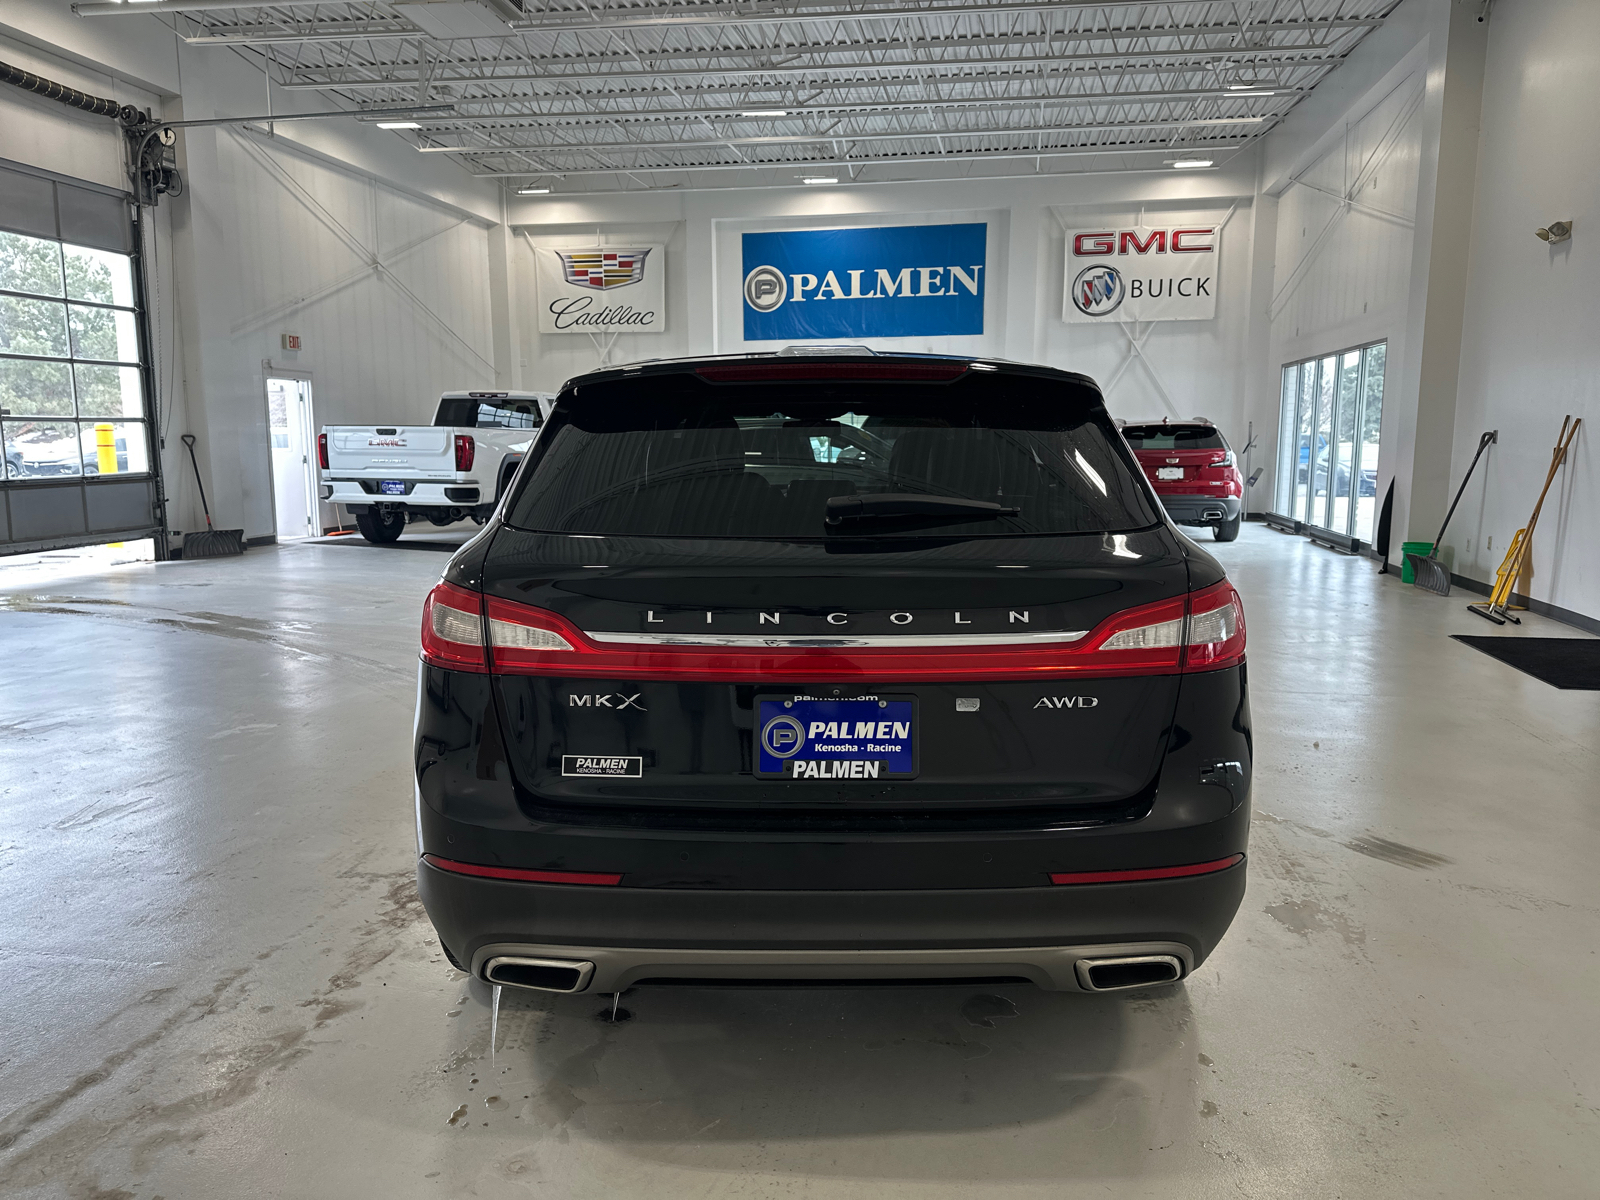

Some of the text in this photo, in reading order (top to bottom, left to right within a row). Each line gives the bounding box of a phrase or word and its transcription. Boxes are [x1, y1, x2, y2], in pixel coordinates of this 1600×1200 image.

[1073, 228, 1214, 257] GMC
[789, 265, 983, 301] PALMEN
[1131, 277, 1211, 298] BUICK
[549, 296, 654, 329] Cadillac
[288, 335, 299, 349] EXIT
[368, 438, 407, 447] GMC
[647, 610, 1030, 625] LINCOLN
[569, 692, 648, 711] MKX
[1033, 696, 1098, 709] AWD
[807, 722, 910, 739] PALMEN
[814, 744, 858, 752] Kenosha
[867, 744, 902, 752] Racine
[576, 758, 628, 769] PALMEN
[792, 761, 880, 779] PALMEN
